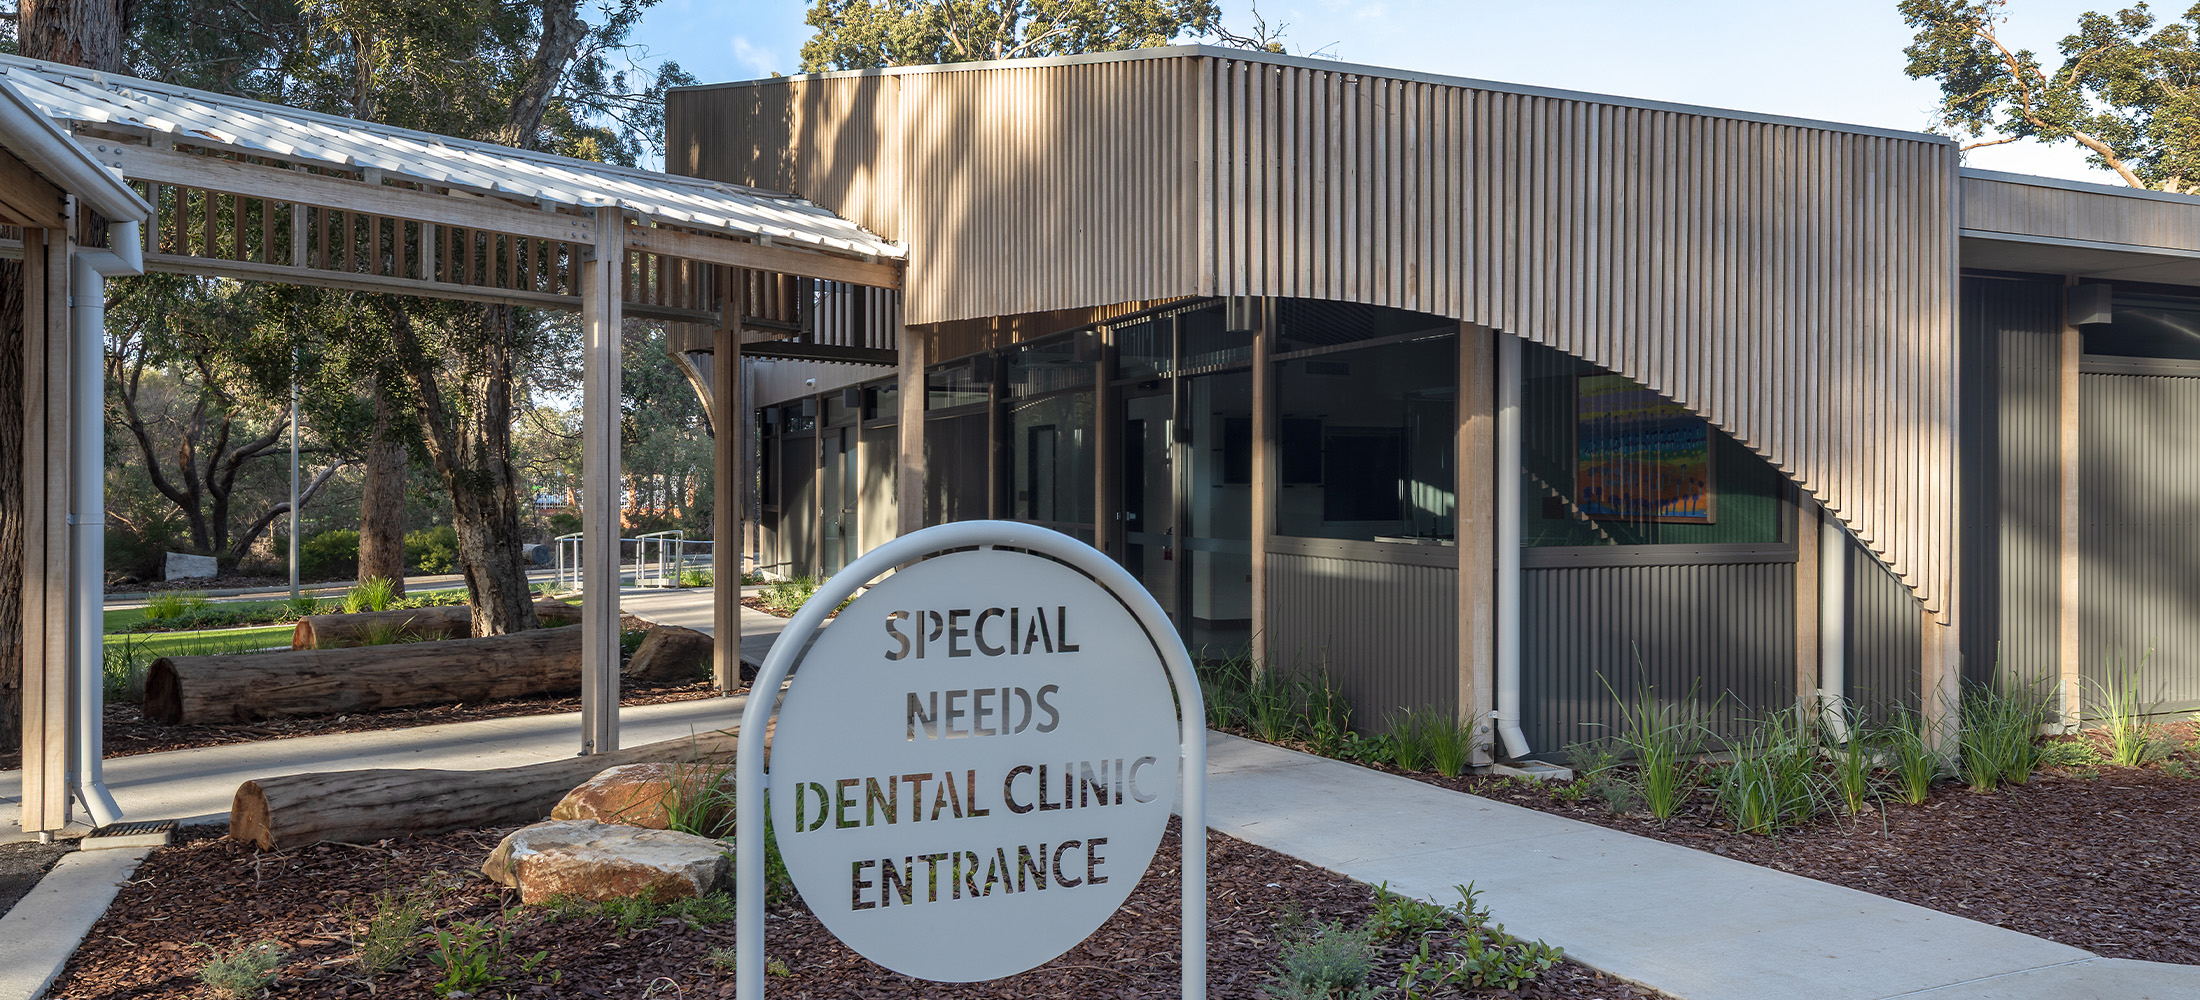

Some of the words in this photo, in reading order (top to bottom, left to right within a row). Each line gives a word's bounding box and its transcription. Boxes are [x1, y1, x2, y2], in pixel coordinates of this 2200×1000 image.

[884, 606, 1080, 661] SPECIAL
[906, 684, 1060, 742] NEEDS
[795, 769, 990, 834] DENTAL
[1003, 756, 1158, 815] CLINIC
[851, 837, 1109, 912] ENTRANCE
